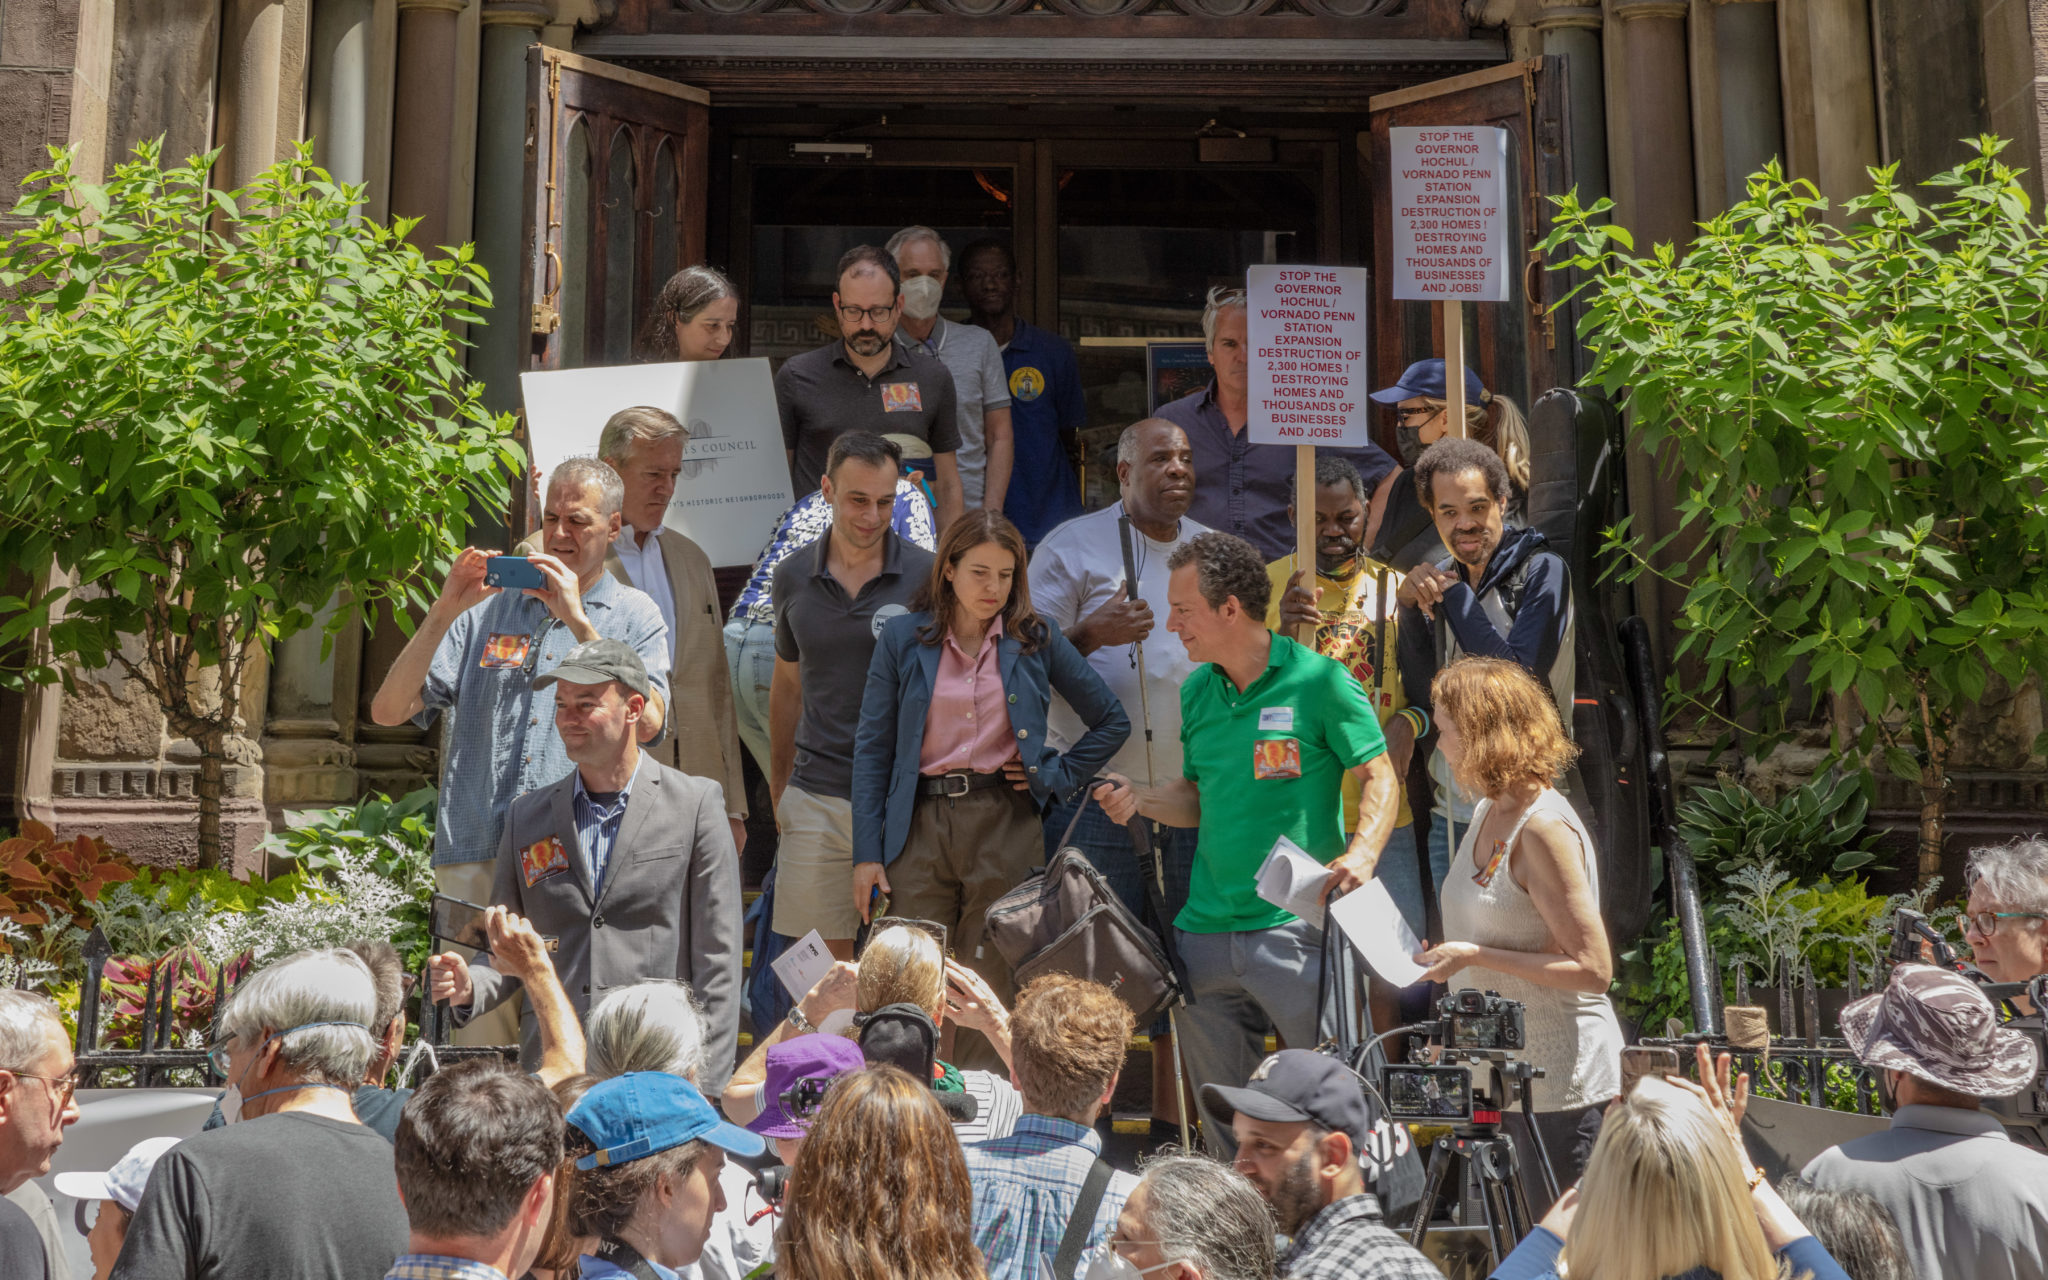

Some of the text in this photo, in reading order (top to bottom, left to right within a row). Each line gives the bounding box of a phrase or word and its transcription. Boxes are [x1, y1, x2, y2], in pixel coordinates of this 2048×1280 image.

[1419, 132, 1474, 142] STOP THE
[1415, 145, 1479, 154] GOVERNOR
[1421, 157, 1468, 167] HOCHUL
[1402, 170, 1491, 179] VORNADO PENN
[1425, 182, 1472, 192] STATION
[1417, 195, 1480, 204] EXPANSION
[1401, 208, 1497, 217] DESTRUCTION OF
[1410, 220, 1438, 230] 2,300
[1441, 220, 1481, 229] HOMES
[1415, 233, 1487, 242] DESTROYING
[1417, 245, 1483, 255] HOMES AND
[1406, 258, 1492, 267] THOUSANDS OF
[1279, 272, 1337, 282] STOP THE
[1415, 271, 1485, 280] BUSINESSES
[1274, 284, 1342, 295] GOVERNOR
[1421, 283, 1482, 293] AND JOBS!
[1281, 297, 1330, 307] HOCHUL
[1261, 310, 1355, 321] VORNADO PENN
[1284, 323, 1333, 333] STATION
[1275, 336, 1342, 346] EXPANSION
[1258, 348, 1361, 360] DESTRUCTION OF
[1268, 361, 1297, 372] 2,300
[1301, 363, 1342, 373] HOMES
[1272, 374, 1349, 386] DESTROYING
[1274, 388, 1344, 399] HOMES AND
[1262, 400, 1355, 412] THOUSANDS OF
[1271, 414, 1346, 425] BUSINESSES
[1278, 427, 1342, 438] AND JOBS!
[702, 441, 757, 453] COUNCIL
[686, 498, 723, 507] HISTORIC
[725, 492, 786, 504] NEIGHBORHOODS
